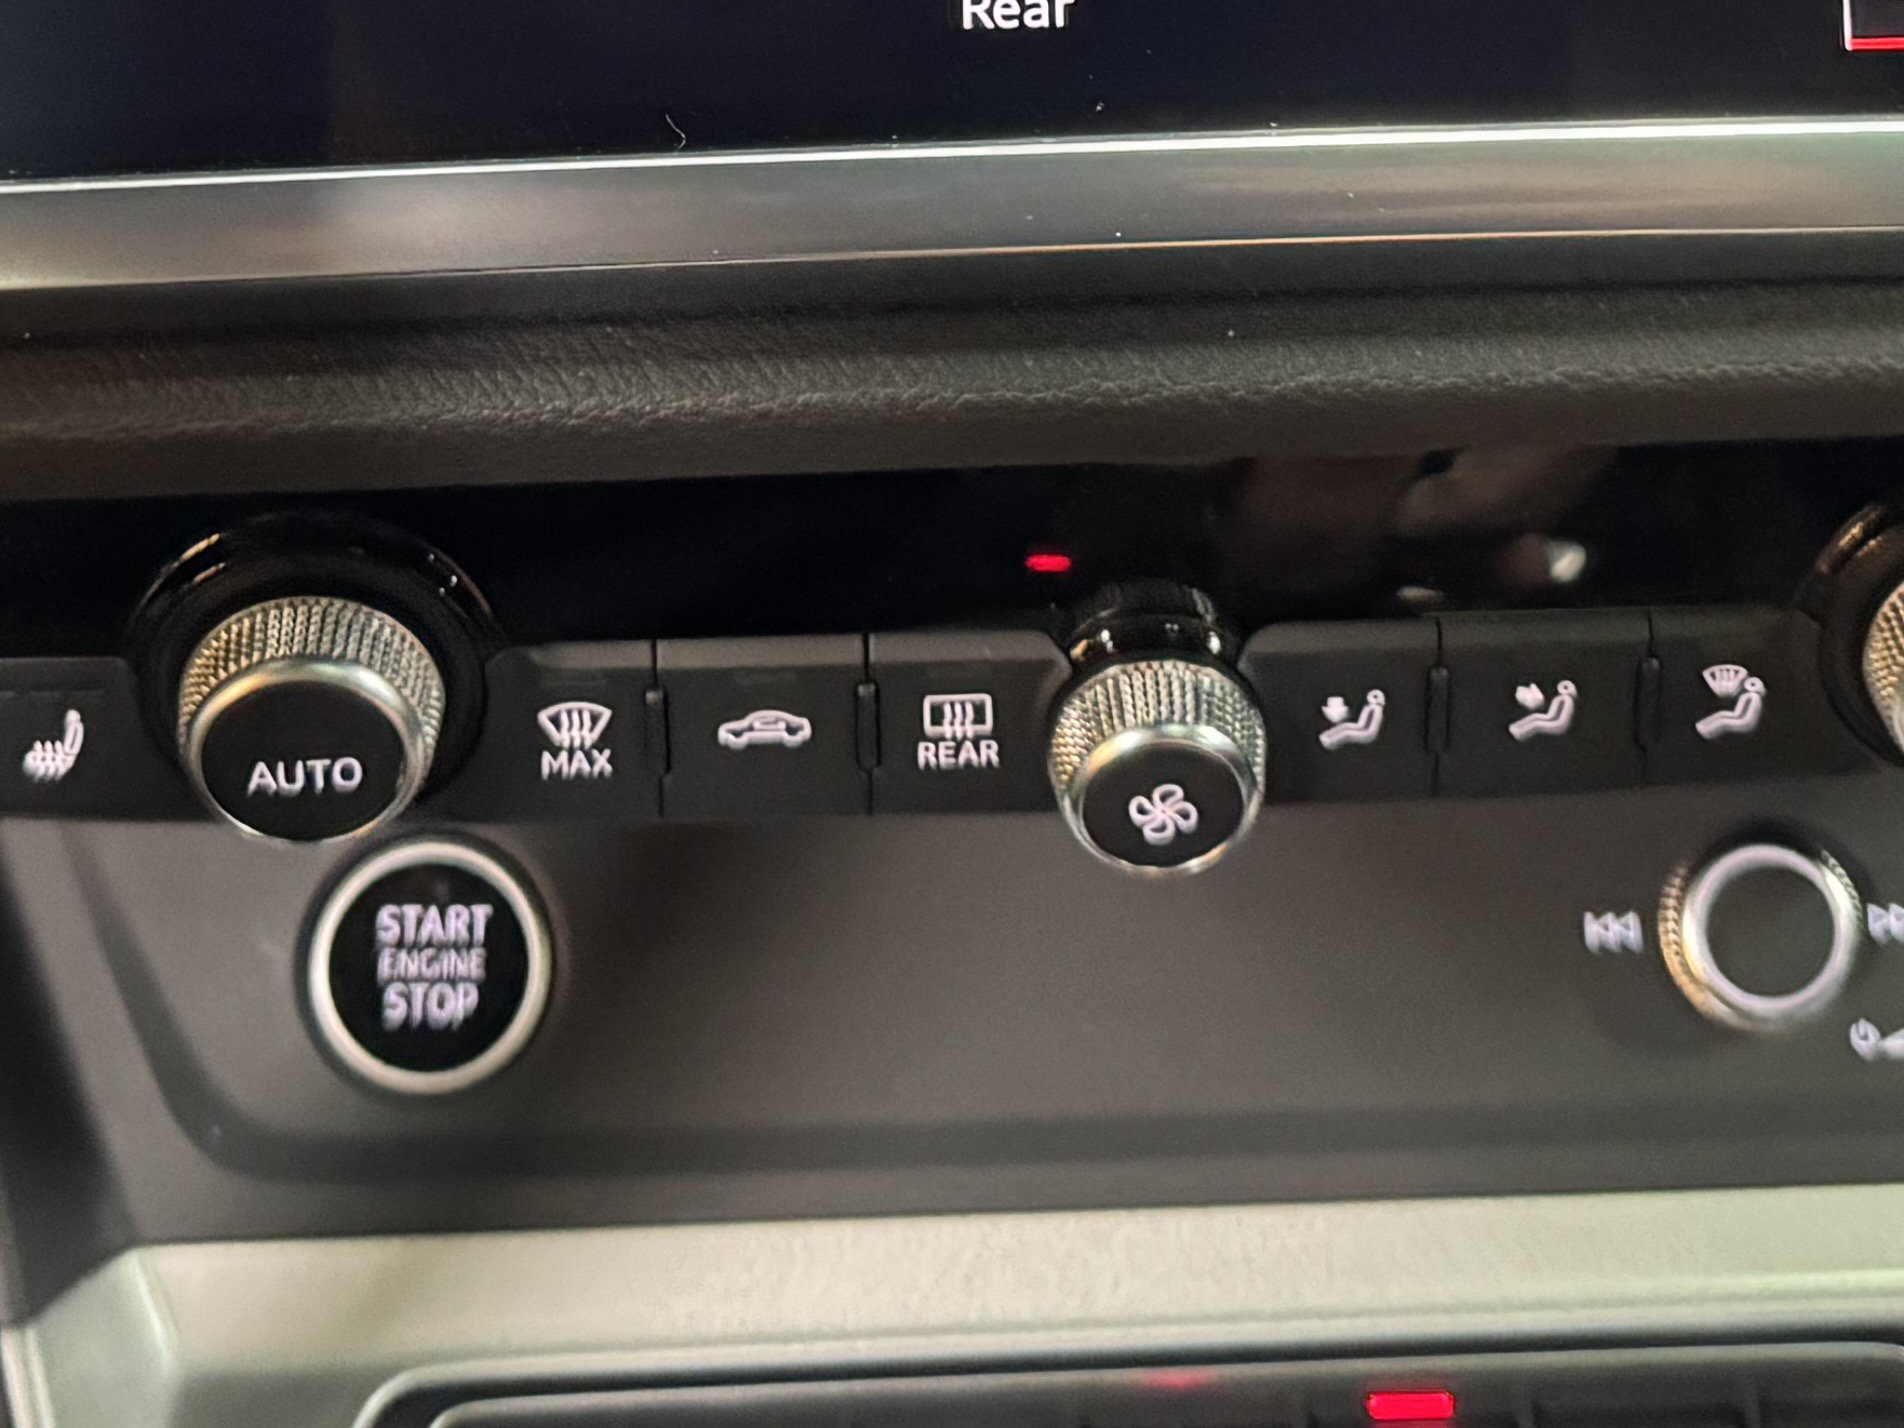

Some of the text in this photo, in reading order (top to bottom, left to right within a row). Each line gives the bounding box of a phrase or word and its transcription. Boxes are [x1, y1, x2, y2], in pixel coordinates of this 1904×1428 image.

[541, 749, 613, 779] MAX
[917, 739, 1000, 770] REAR
[247, 756, 364, 797] AUTO
[376, 903, 493, 945] START
[377, 947, 487, 983] ENGINE
[381, 982, 480, 1032] STOP
